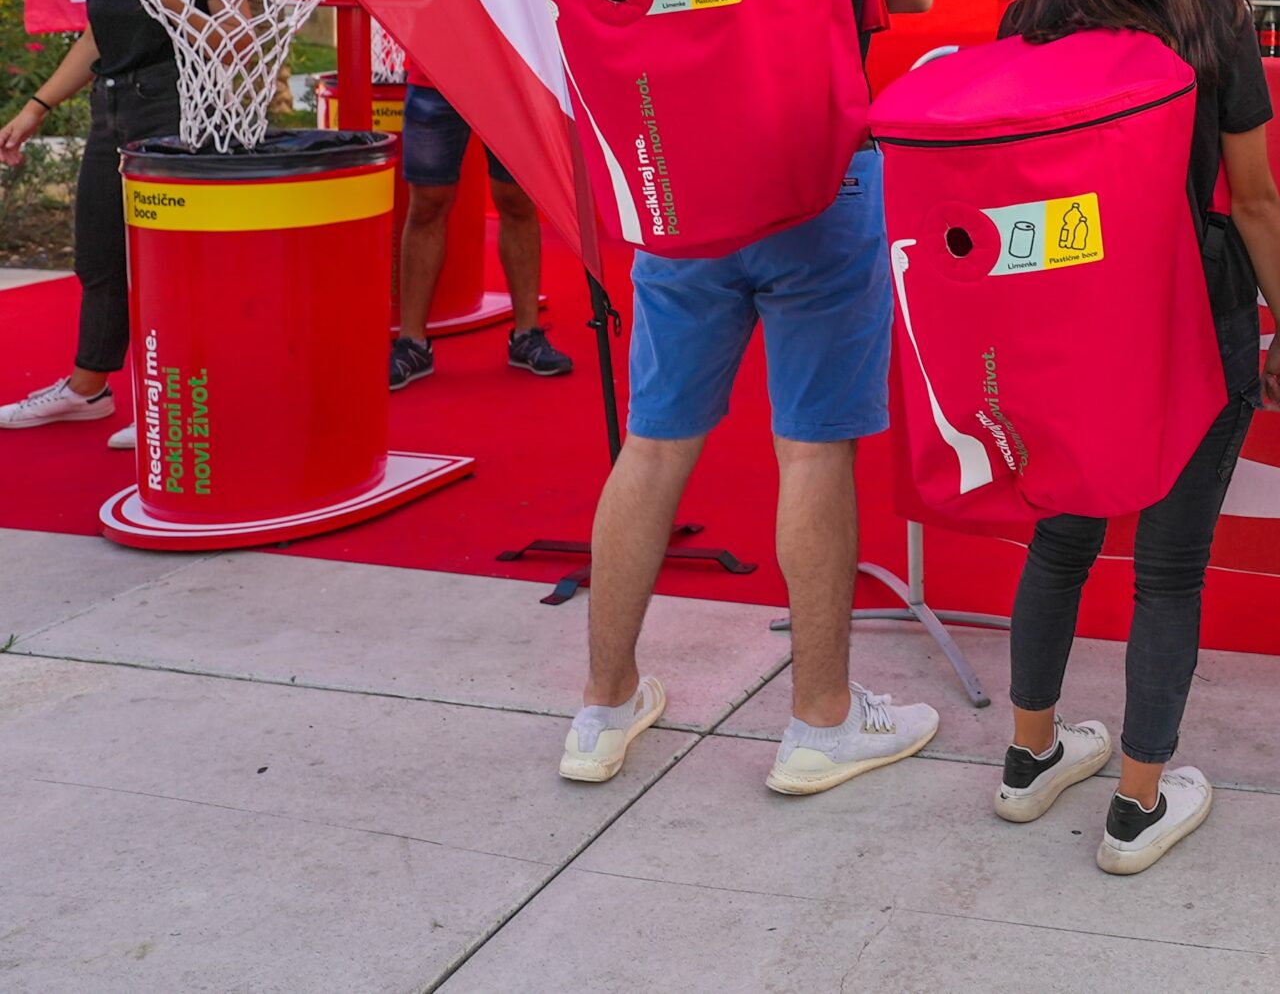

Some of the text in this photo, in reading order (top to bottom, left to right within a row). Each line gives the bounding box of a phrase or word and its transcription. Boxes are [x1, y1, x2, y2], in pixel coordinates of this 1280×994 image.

[134, 190, 185, 207] Plastične
[635, 134, 665, 236] Recikliraj me.
[636, 72, 679, 235] Pokloni mi novi život.
[134, 206, 157, 220] boce
[144, 329, 162, 490] Recikliraj me.
[981, 346, 999, 395] život.
[162, 367, 184, 493] Pokloni mi
[187, 368, 211, 494] novi život.
